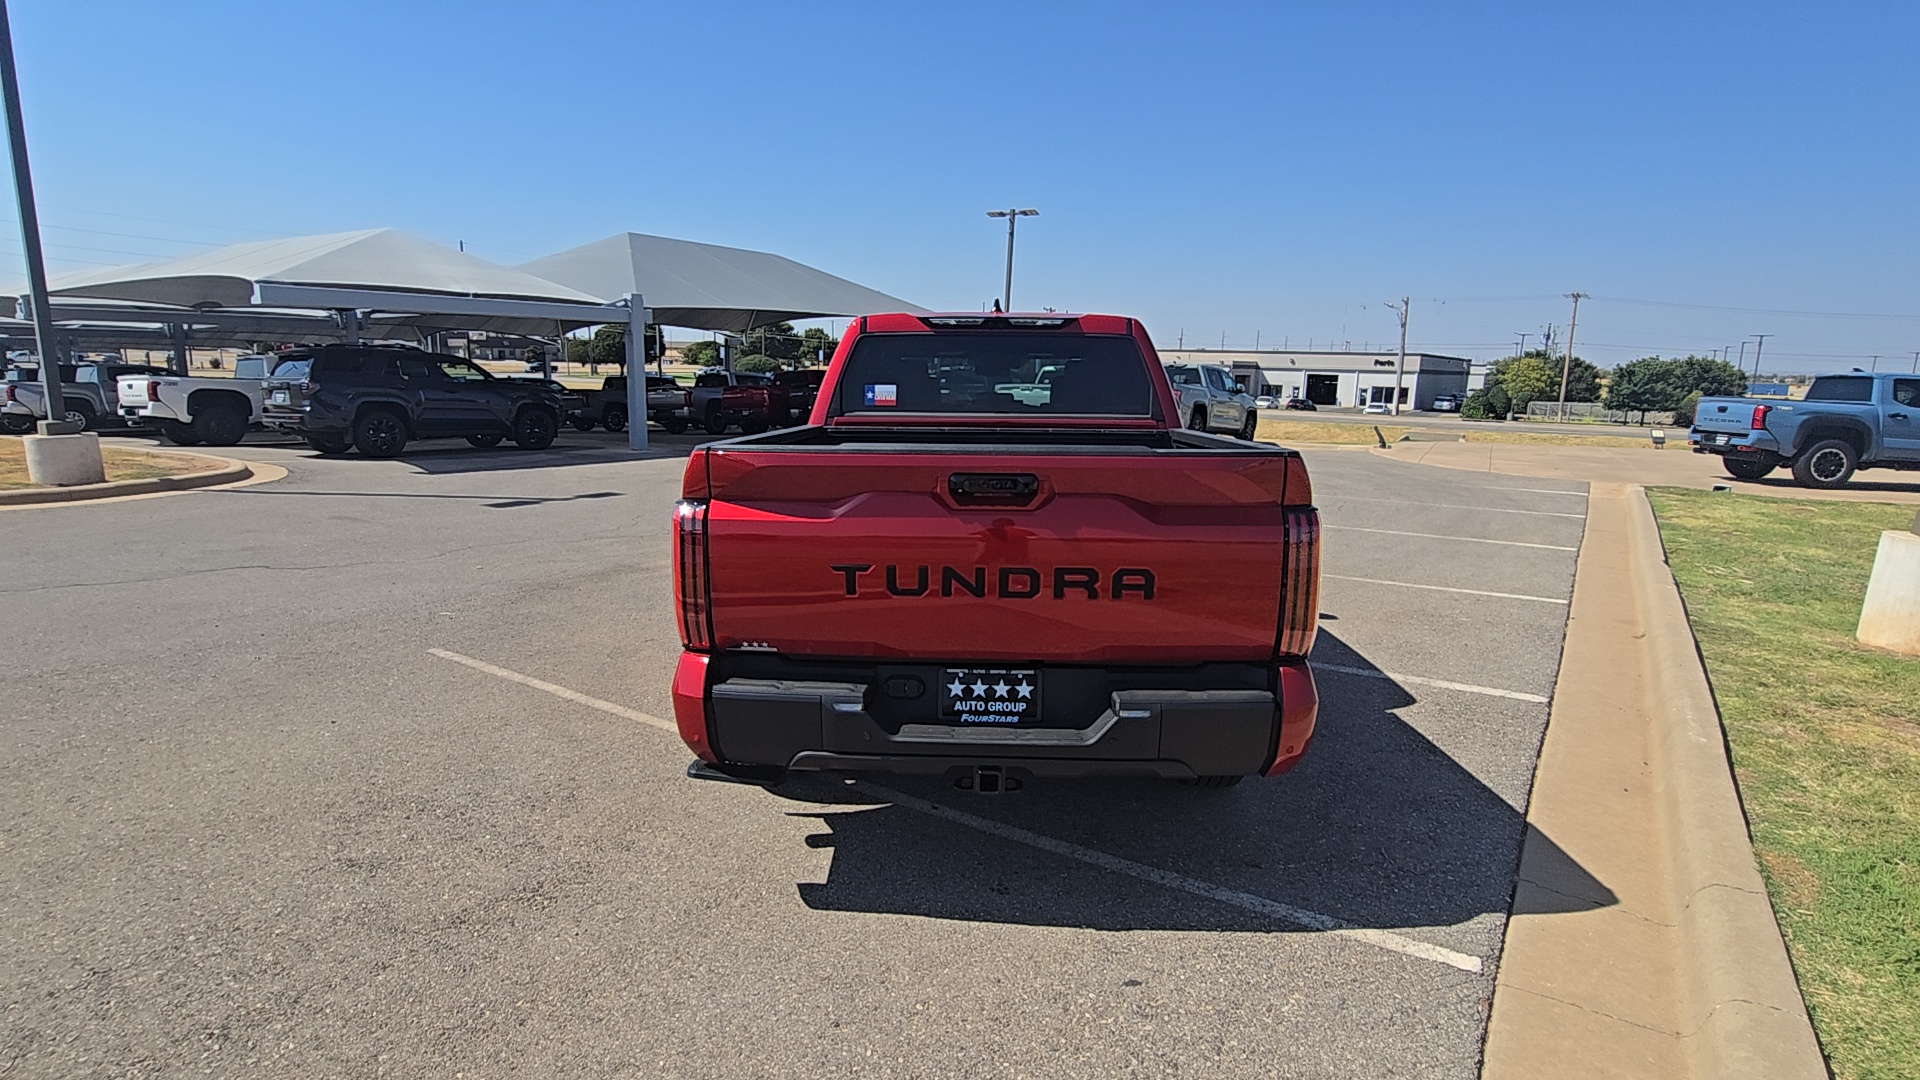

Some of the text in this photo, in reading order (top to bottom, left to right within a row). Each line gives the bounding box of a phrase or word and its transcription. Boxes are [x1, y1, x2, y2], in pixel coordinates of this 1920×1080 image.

[829, 564, 1156, 600] TUNDRA
[953, 700, 1027, 713] AUTO GROUP
